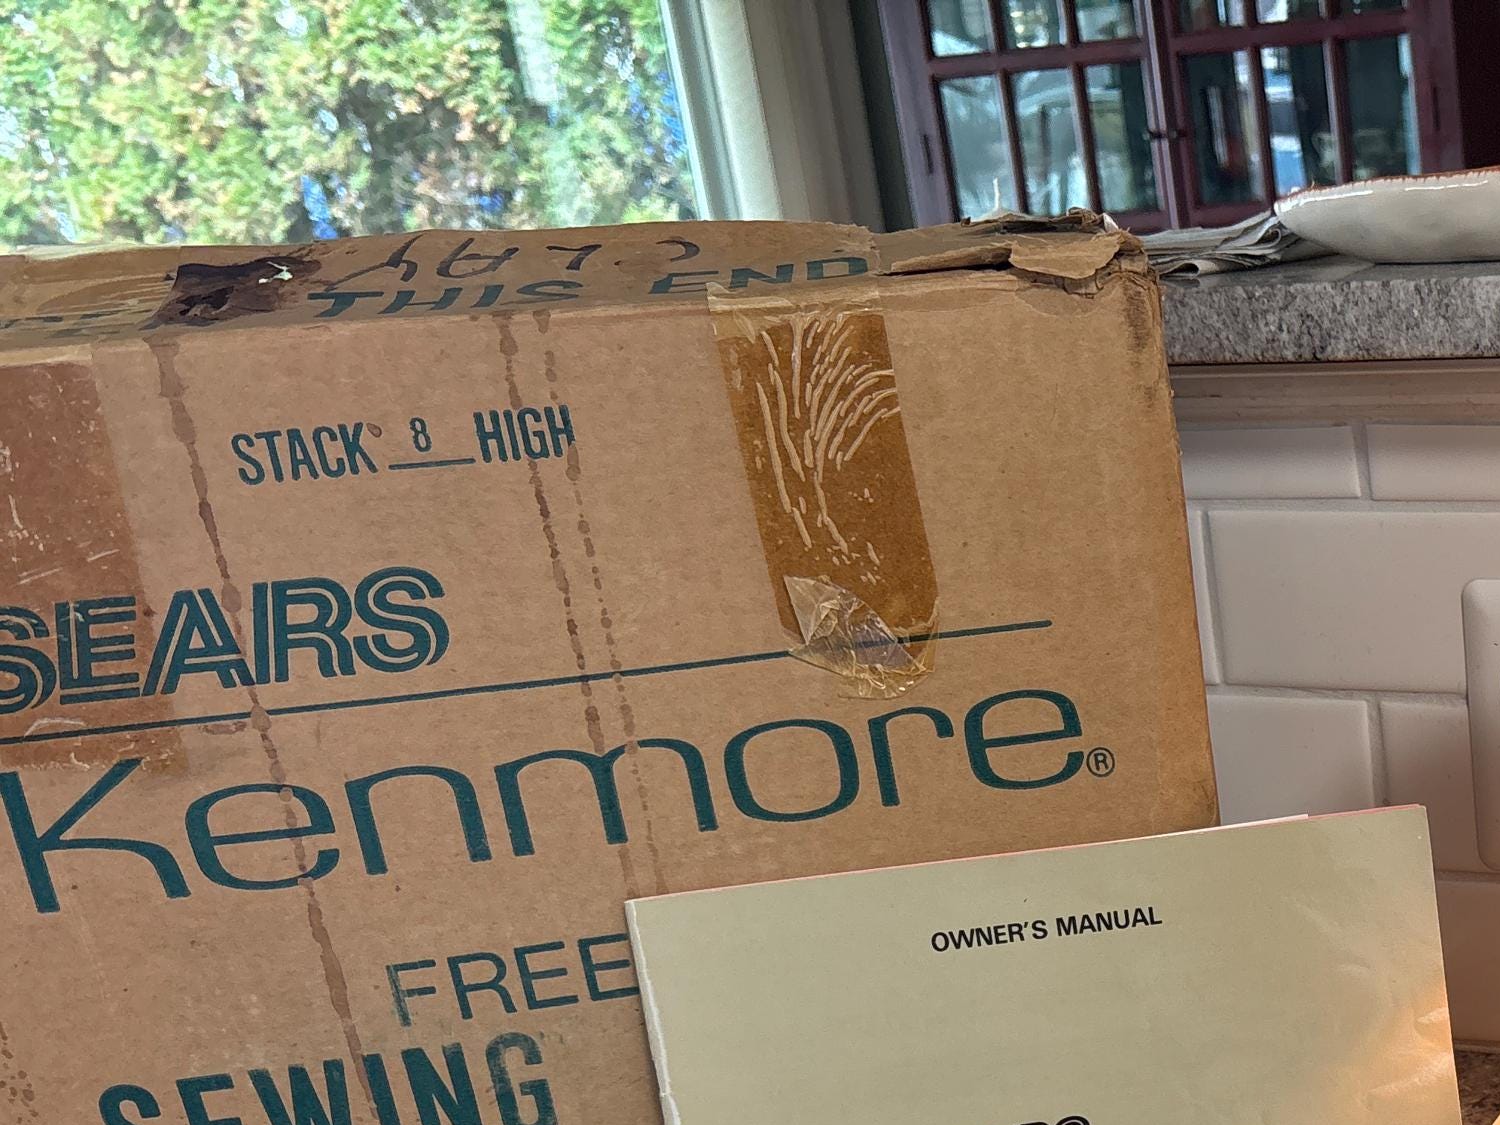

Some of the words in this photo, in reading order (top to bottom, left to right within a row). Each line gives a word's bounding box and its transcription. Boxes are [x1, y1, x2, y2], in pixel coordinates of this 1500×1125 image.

[307, 279, 585, 318] THIS
[650, 257, 868, 294] END
[231, 422, 379, 485] STACK
[409, 417, 432, 453] 8
[474, 405, 575, 462] HIGH
[931, 919, 1048, 952] OWNER'S
[1056, 906, 1162, 936] MANUAL
[386, 932, 641, 1027] FREE
